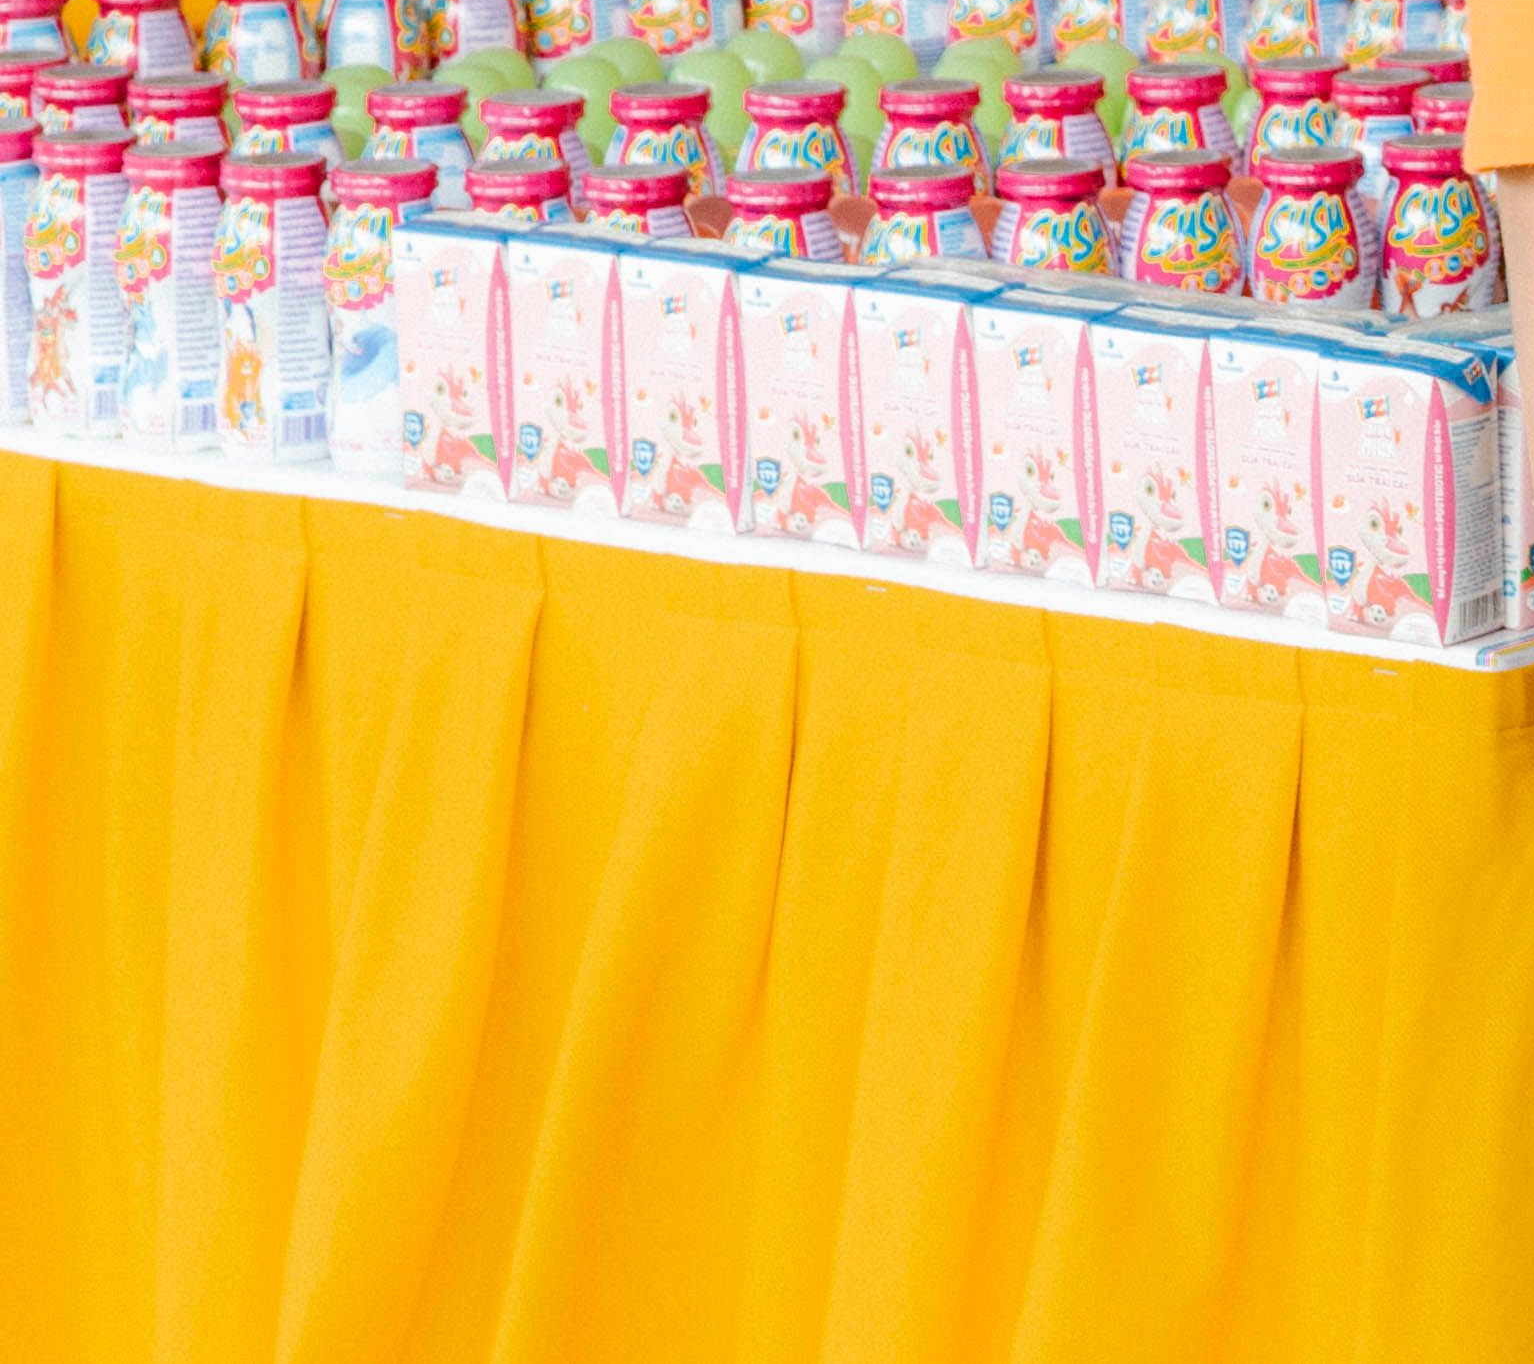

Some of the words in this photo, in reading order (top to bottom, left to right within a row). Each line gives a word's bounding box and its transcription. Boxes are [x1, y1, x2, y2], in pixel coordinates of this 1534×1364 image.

[1021, 207, 1106, 268] SuSu
[1147, 197, 1232, 258] SuSu
[1262, 195, 1347, 253] SuSu
[1393, 180, 1478, 241] SuSu
